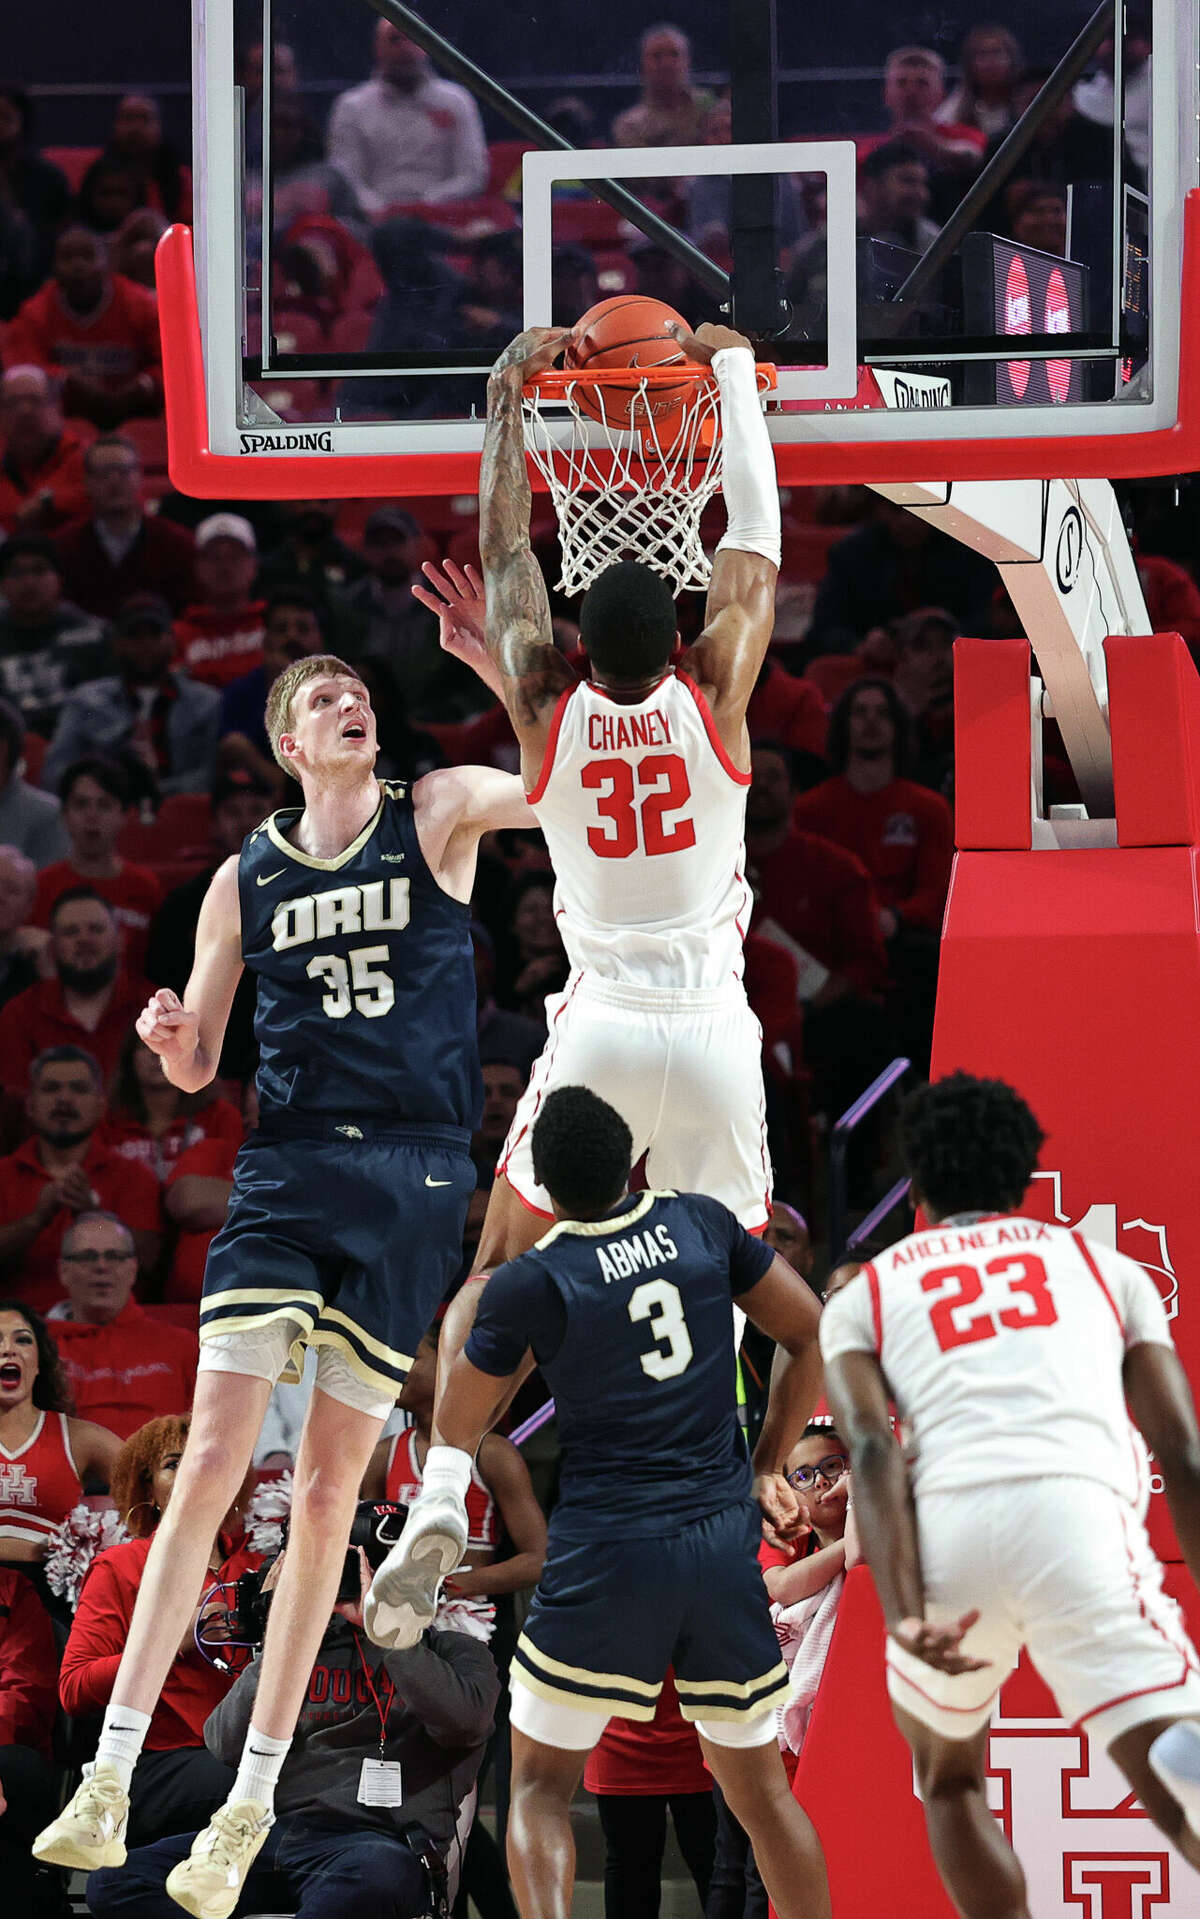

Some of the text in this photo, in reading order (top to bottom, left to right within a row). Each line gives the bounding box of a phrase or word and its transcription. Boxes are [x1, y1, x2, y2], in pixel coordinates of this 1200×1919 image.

[240, 431, 334, 455] SPALDING
[588, 709, 672, 751] CHANEY
[580, 754, 696, 859] 32
[271, 877, 410, 952] ORU
[305, 944, 395, 1019] 35
[596, 1224, 678, 1284] ABMAS
[893, 1224, 1052, 1270] ARCENEAUX
[627, 1277, 694, 1383] 3
[920, 1252, 1059, 1353] 23
